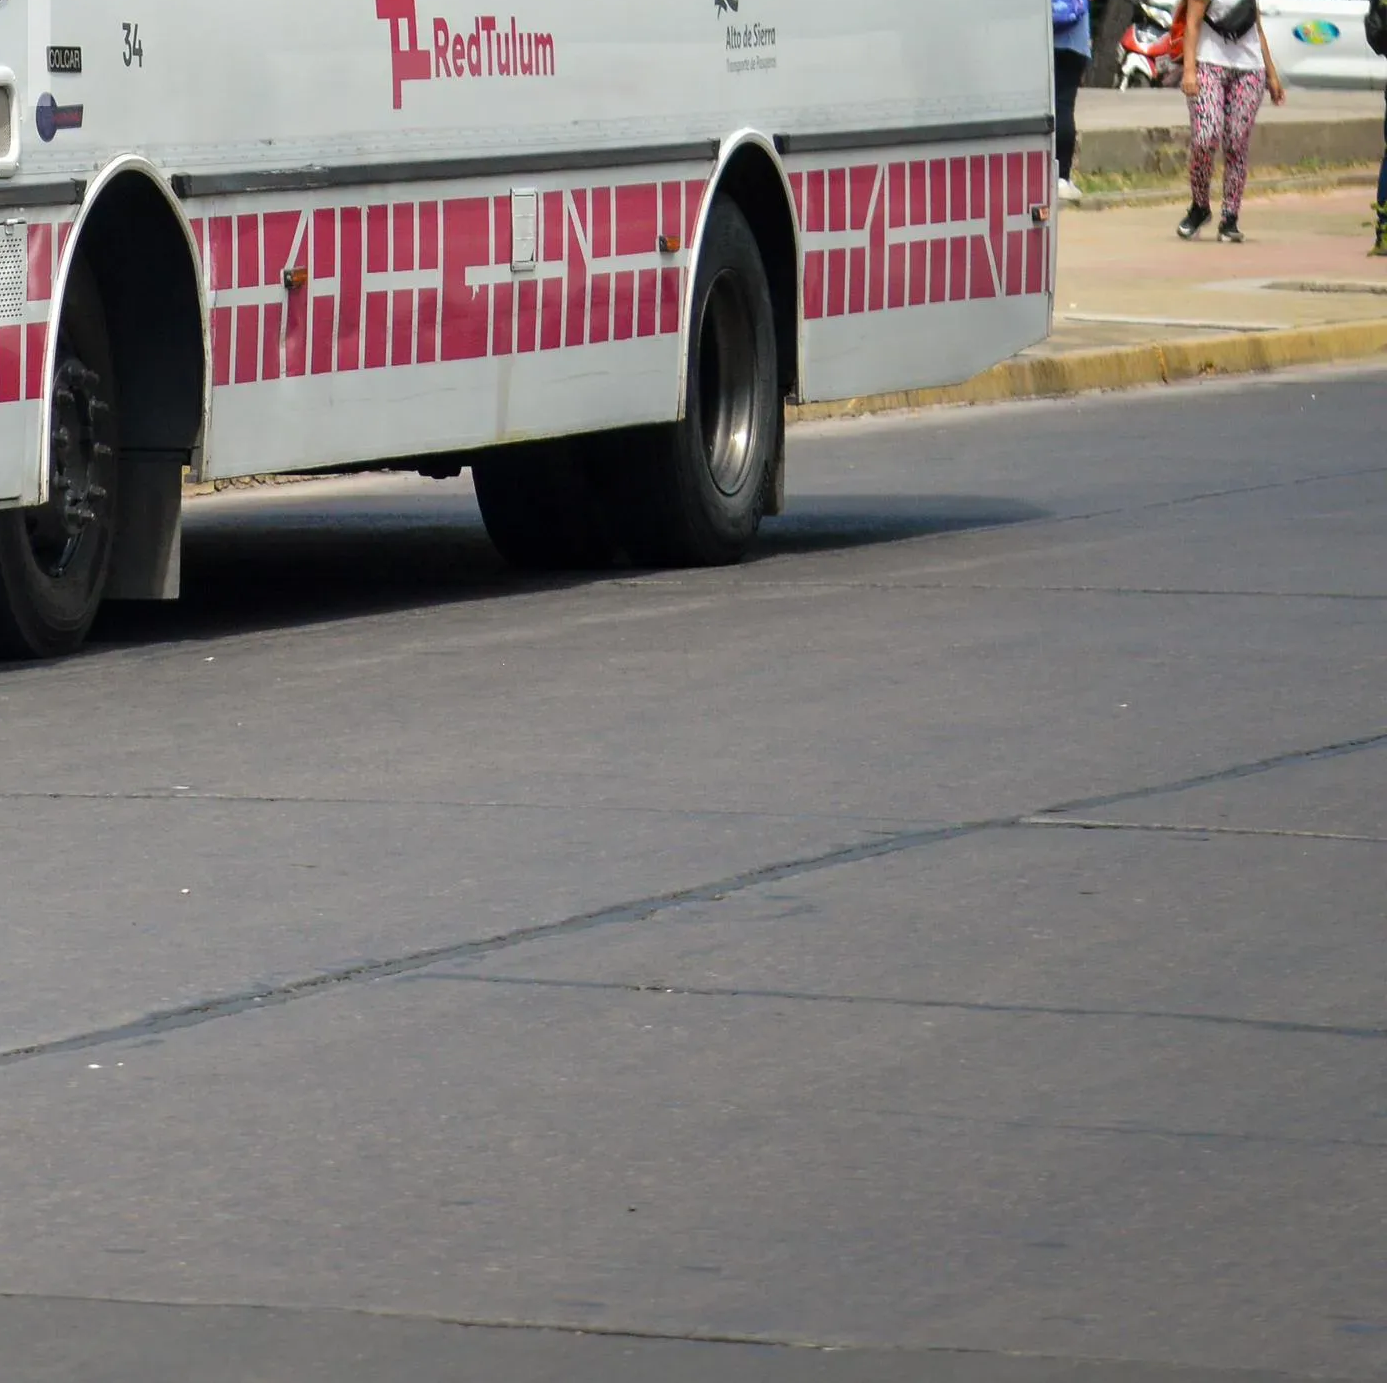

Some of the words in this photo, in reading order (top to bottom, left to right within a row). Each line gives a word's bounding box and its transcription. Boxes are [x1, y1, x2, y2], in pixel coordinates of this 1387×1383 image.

[122, 22, 143, 68] 34
[433, 16, 555, 78] RedTulum
[726, 25, 741, 50] Alto
[743, 24, 752, 48] de
[753, 22, 775, 47] Sierra
